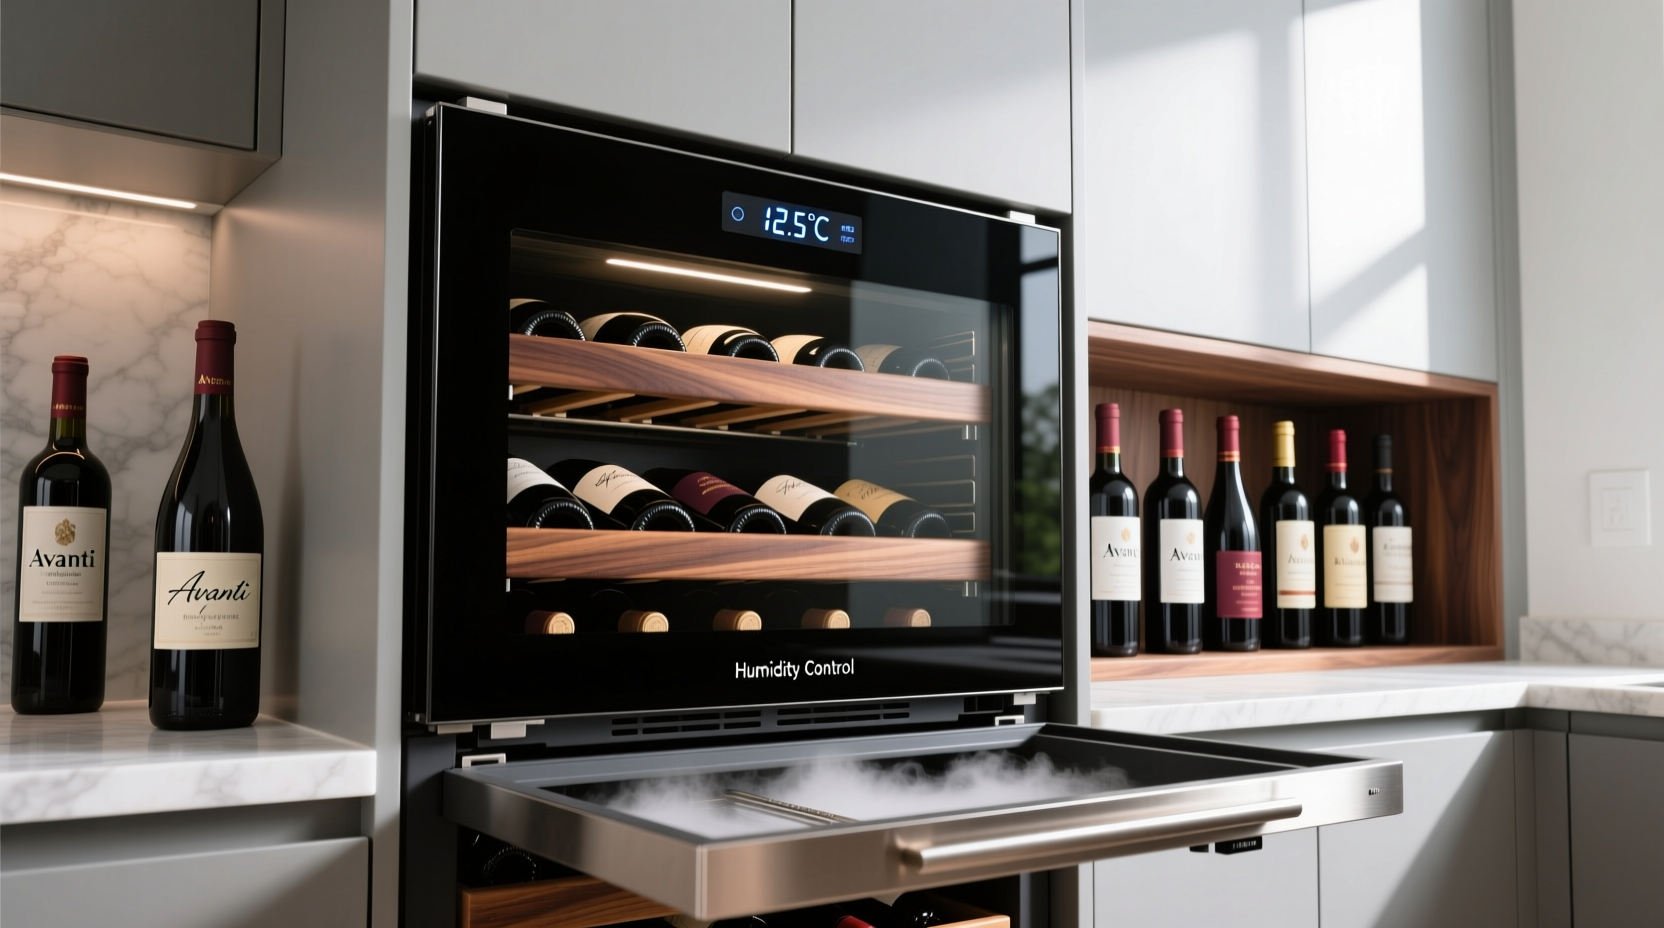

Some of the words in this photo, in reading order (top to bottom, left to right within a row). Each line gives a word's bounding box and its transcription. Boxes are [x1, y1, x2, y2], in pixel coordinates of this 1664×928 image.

[764, 206, 830, 242] 12.5°C
[28, 548, 95, 568] Avanti
[168, 570, 251, 606] Avanti
[735, 659, 801, 681] Humidity
[804, 657, 856, 676] Control
